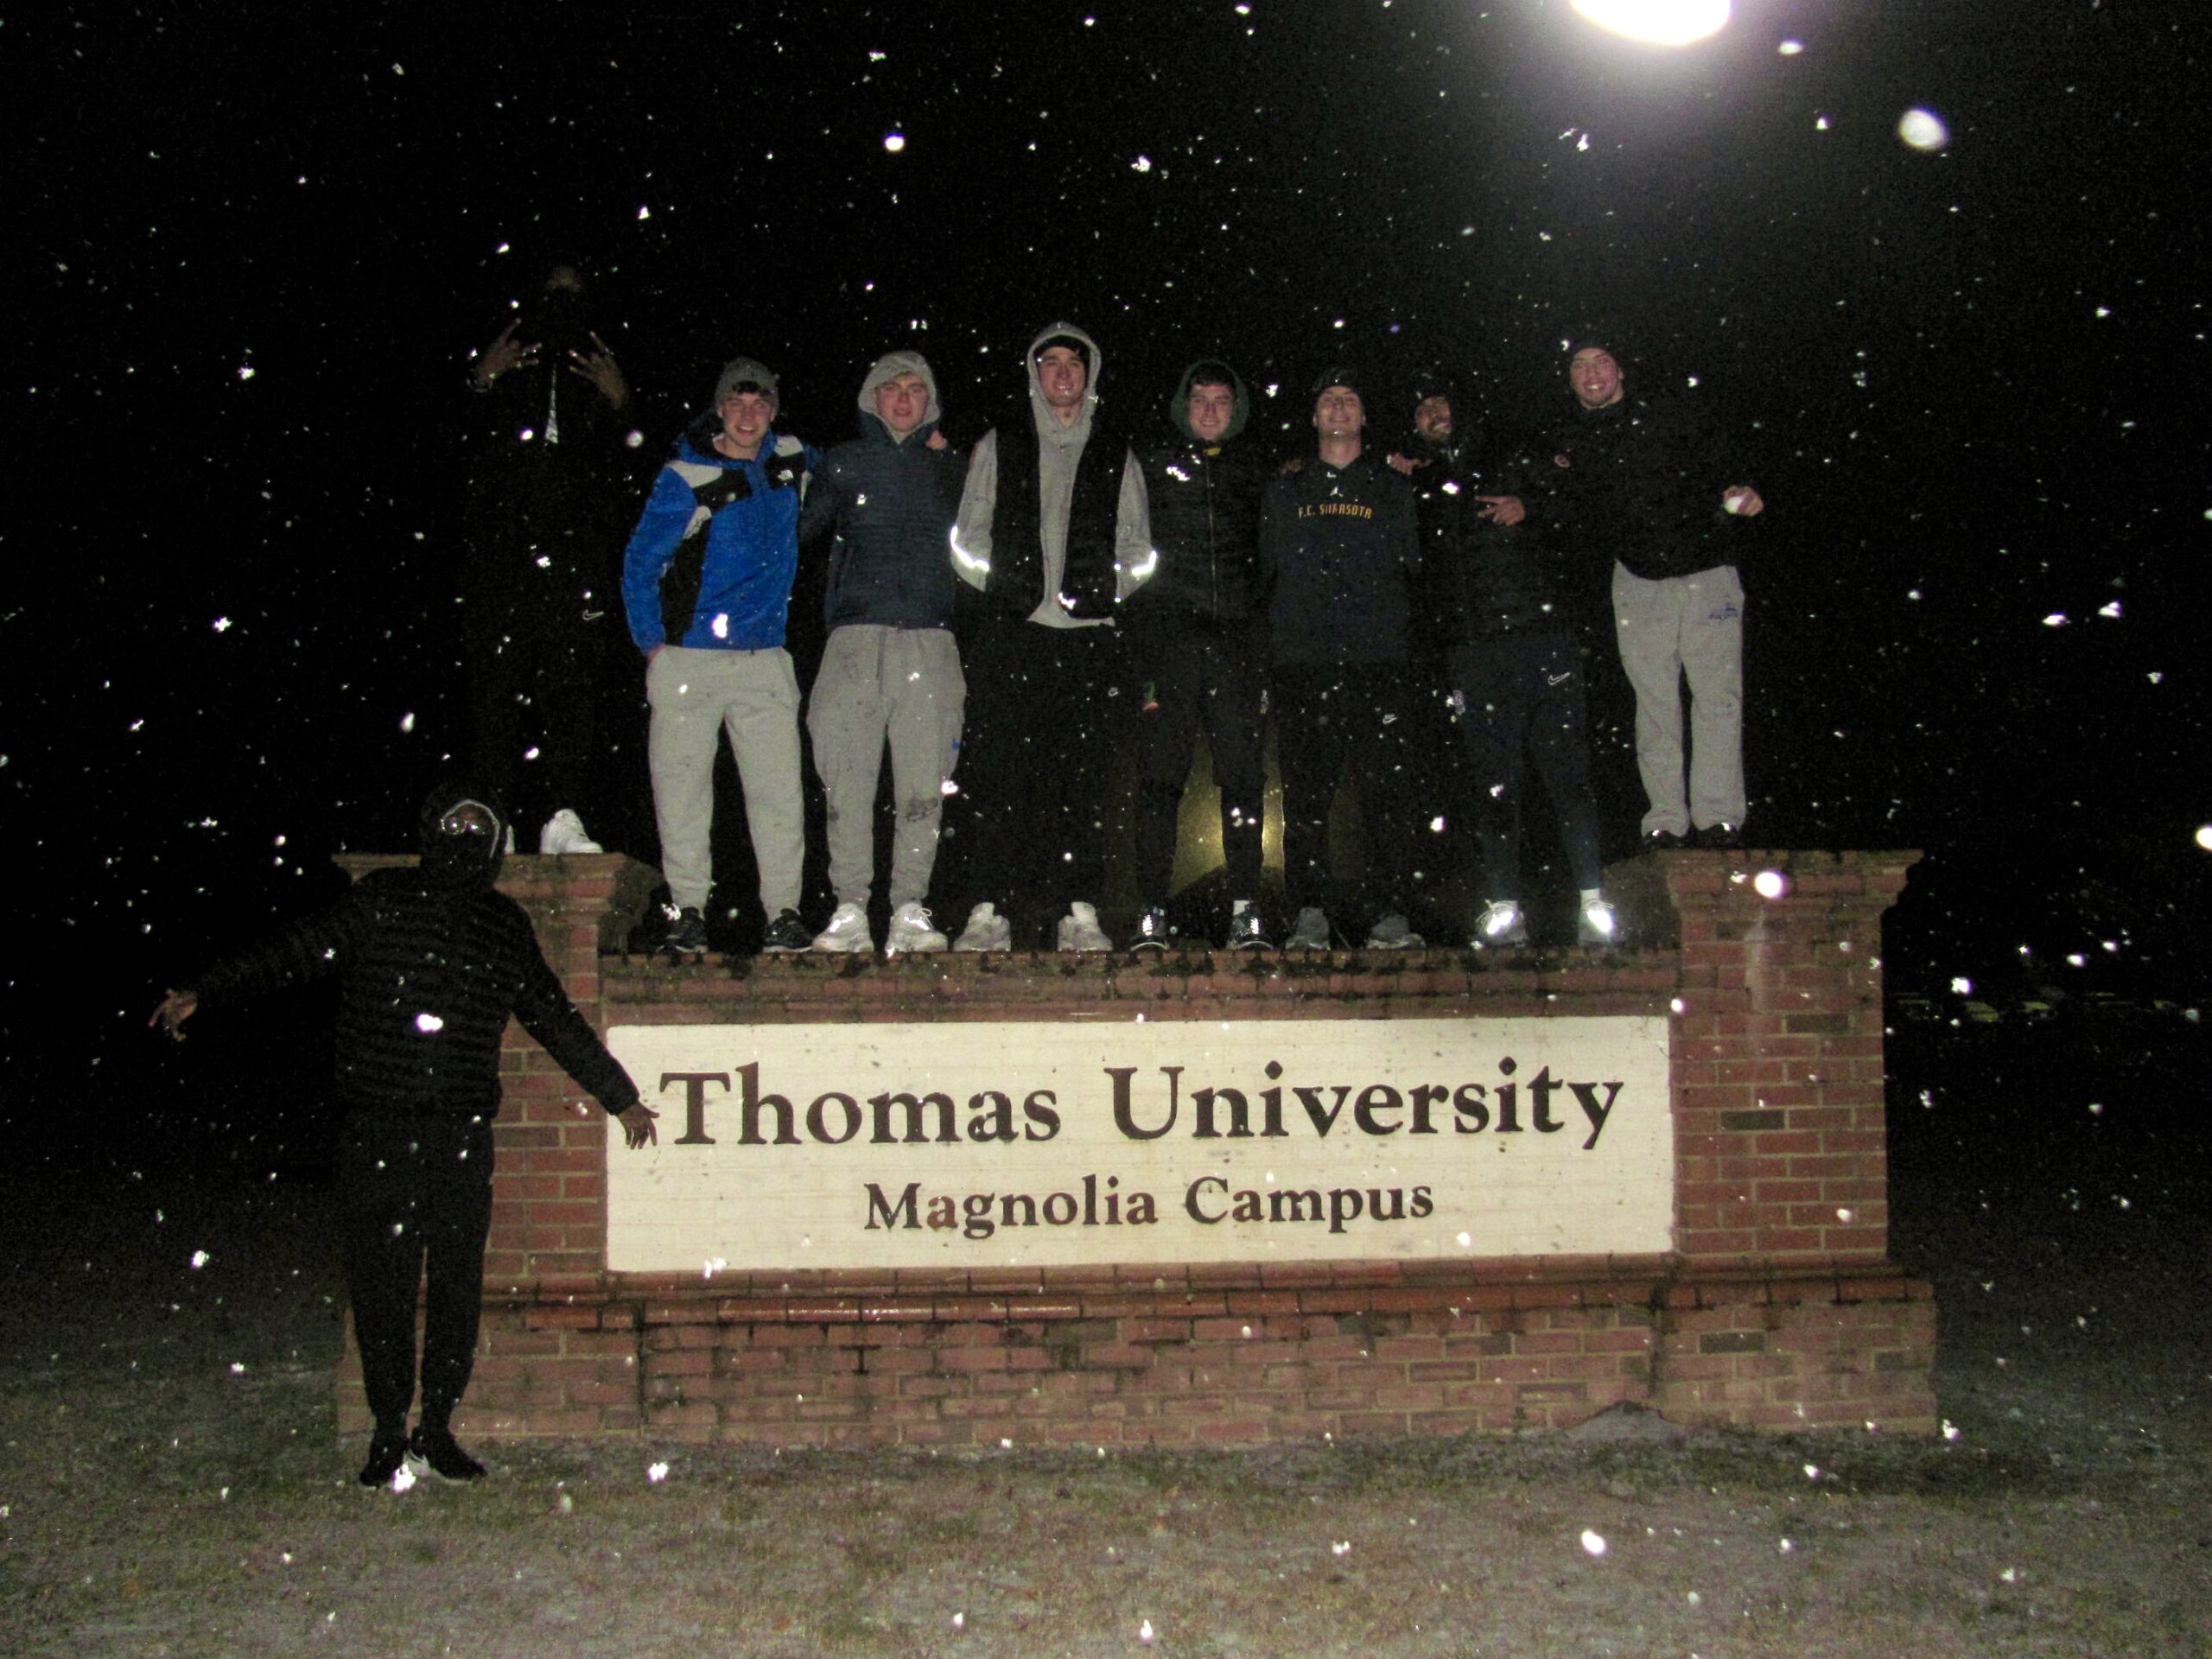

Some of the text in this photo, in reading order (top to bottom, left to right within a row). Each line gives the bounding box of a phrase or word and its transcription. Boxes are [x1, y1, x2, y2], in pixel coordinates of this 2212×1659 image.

[1298, 505, 1315, 518] F.C.
[660, 1057, 1624, 1149] Thomas University
[865, 1174, 1433, 1239] Magnolia Campus
